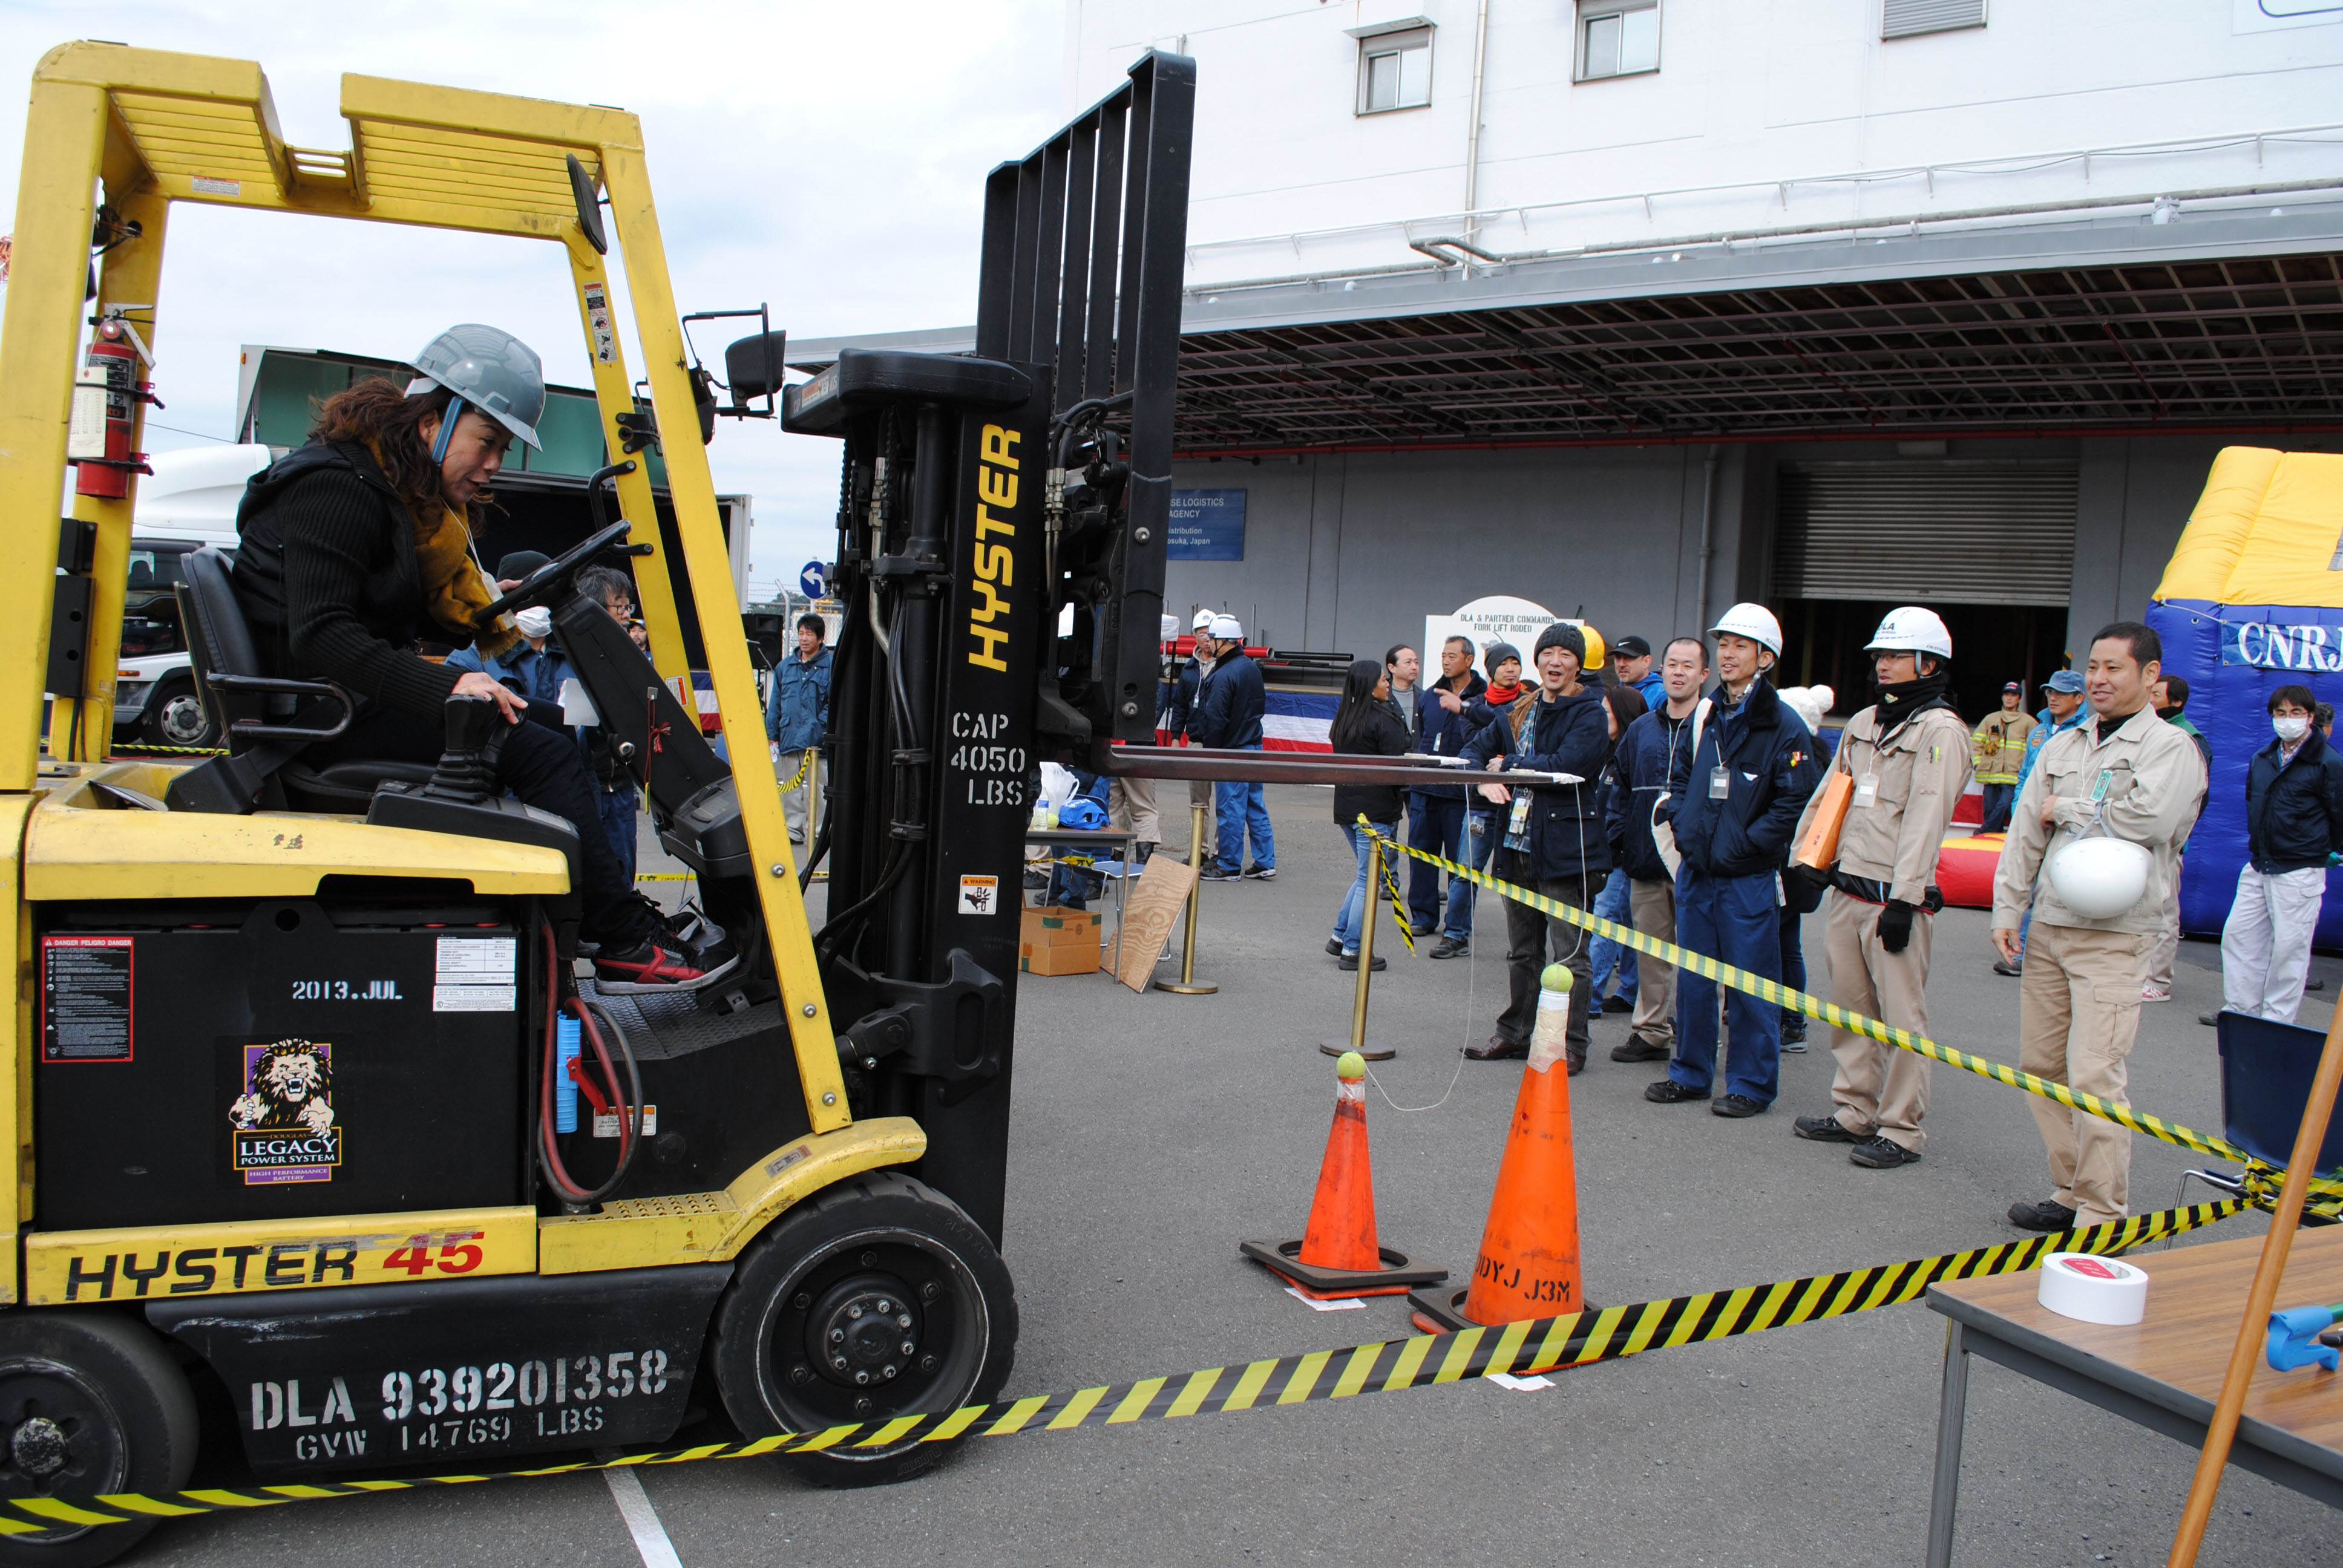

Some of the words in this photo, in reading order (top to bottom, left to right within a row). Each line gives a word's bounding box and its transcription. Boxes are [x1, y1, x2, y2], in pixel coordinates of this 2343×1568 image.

[1182, 498, 1224, 507] LOGISTICS
[1168, 509, 1200, 518] AGENCY
[968, 423, 1021, 673] HYSTER
[1190, 537, 1210, 546] Japan
[1484, 615, 1515, 623] PARTNER
[1516, 615, 1555, 624] COMMANDS
[1493, 624, 1507, 633] LIFT
[1510, 624, 1532, 633] RODEO
[953, 712, 1009, 739] CAP
[951, 745, 1026, 773] 4050
[968, 779, 1023, 805] LBS
[292, 981, 402, 999] 2013.JUL
[240, 1138, 338, 1156] LEGACY
[241, 1156, 286, 1165] POWER
[289, 1154, 335, 1163] SYSTEM
[65, 1241, 358, 1301] HYSTER
[383, 1231, 485, 1275] 45
[1524, 1279, 1570, 1302] J3M
[252, 1376, 356, 1430] DLA
[382, 1349, 667, 1420] 939201358
[297, 1429, 366, 1460] GVW
[402, 1416, 510, 1451] 14769
[538, 1406, 603, 1436] LBS
